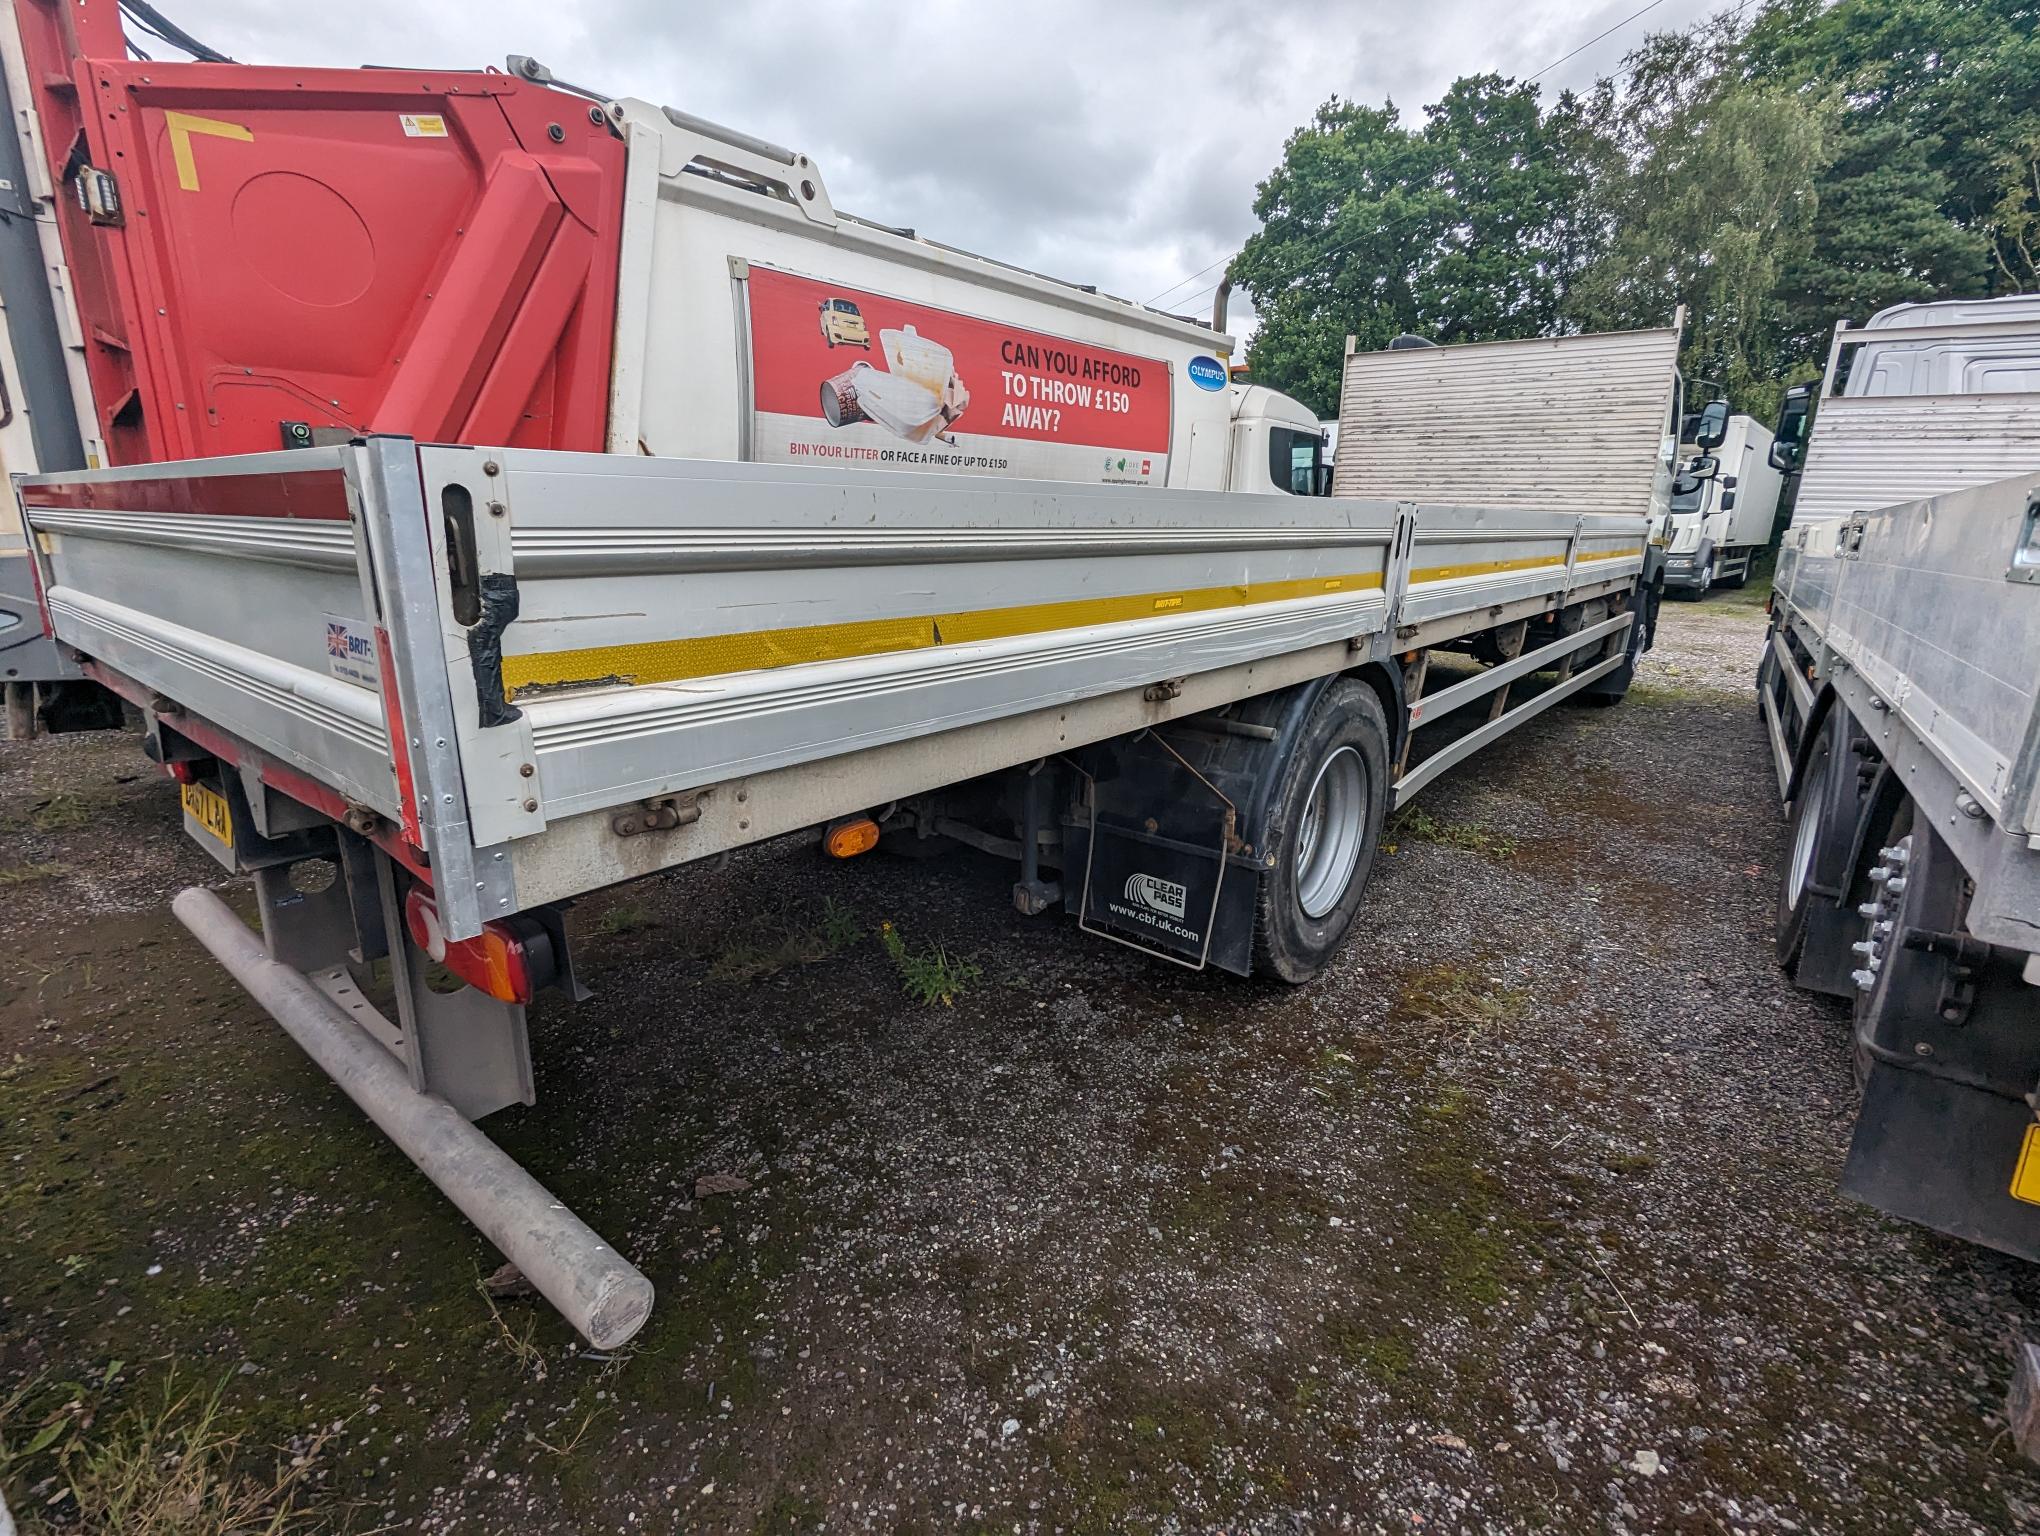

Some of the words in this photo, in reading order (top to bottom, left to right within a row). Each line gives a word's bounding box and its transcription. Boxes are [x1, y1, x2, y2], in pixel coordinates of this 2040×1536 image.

[1001, 340, 1039, 370] CAN
[1043, 349, 1078, 376] YOU
[1082, 357, 1141, 388] AFFORD
[1191, 365, 1225, 381] OLYMPUS
[1001, 370, 1027, 398] TO
[1029, 376, 1092, 408] THROW
[1095, 389, 1130, 414] £150
[1001, 403, 1061, 432] AWAY?
[790, 442, 810, 456] BIN
[812, 444, 842, 458] YOUR
[844, 446, 879, 461] LITTER
[880, 450, 895, 462] OR
[896, 451, 919, 463] FACE
[920, 453, 928, 464] A
[929, 454, 949, 465] FINE
[950, 455, 963, 466] OF
[964, 457, 975, 467] UP
[976, 458, 988, 468] TO
[988, 459, 1008, 469] £150
[1146, 878, 1183, 898] CLEAR
[1154, 891, 1182, 908] PASS
[1109, 903, 1199, 942] www.cbf.uk.com
